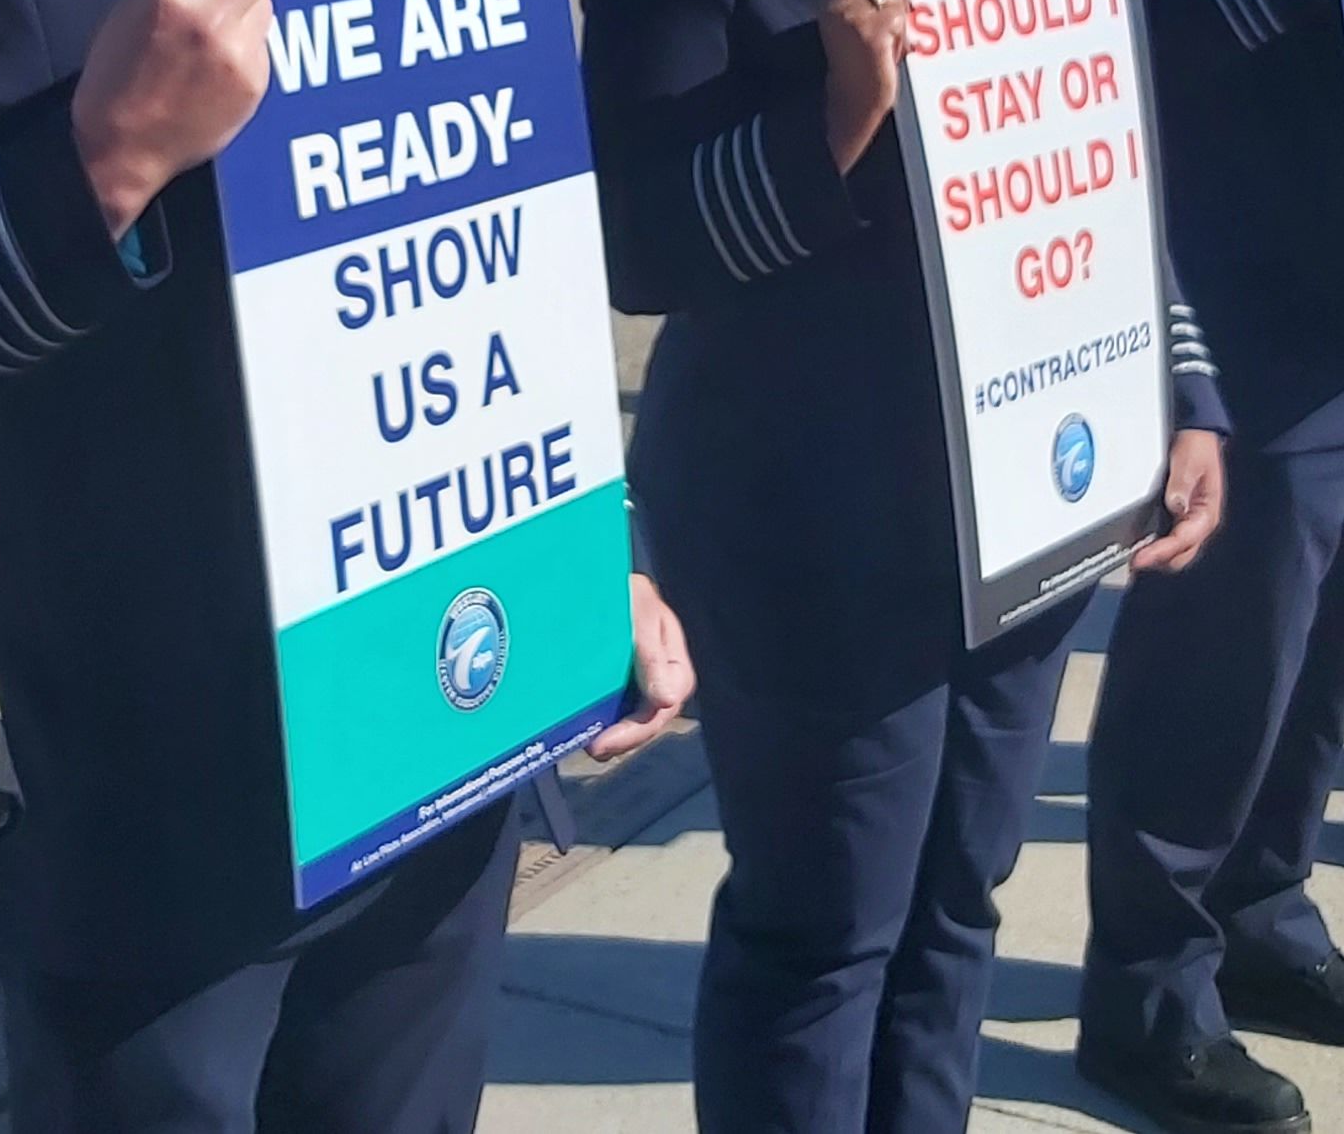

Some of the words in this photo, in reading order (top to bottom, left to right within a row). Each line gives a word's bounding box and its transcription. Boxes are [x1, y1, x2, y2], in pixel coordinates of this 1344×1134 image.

[939, 69, 1044, 143] STAY
[1060, 53, 1120, 113] OR
[289, 86, 534, 220] READY-
[942, 139, 1116, 234] SHOULD
[1126, 132, 1140, 179] I
[333, 206, 524, 331] SHOW
[1014, 229, 1095, 301] GO?
[371, 351, 459, 445] US
[482, 332, 522, 408] A
[976, 322, 1153, 416] #CONTRACT2023
[328, 422, 578, 595] FUTURE
